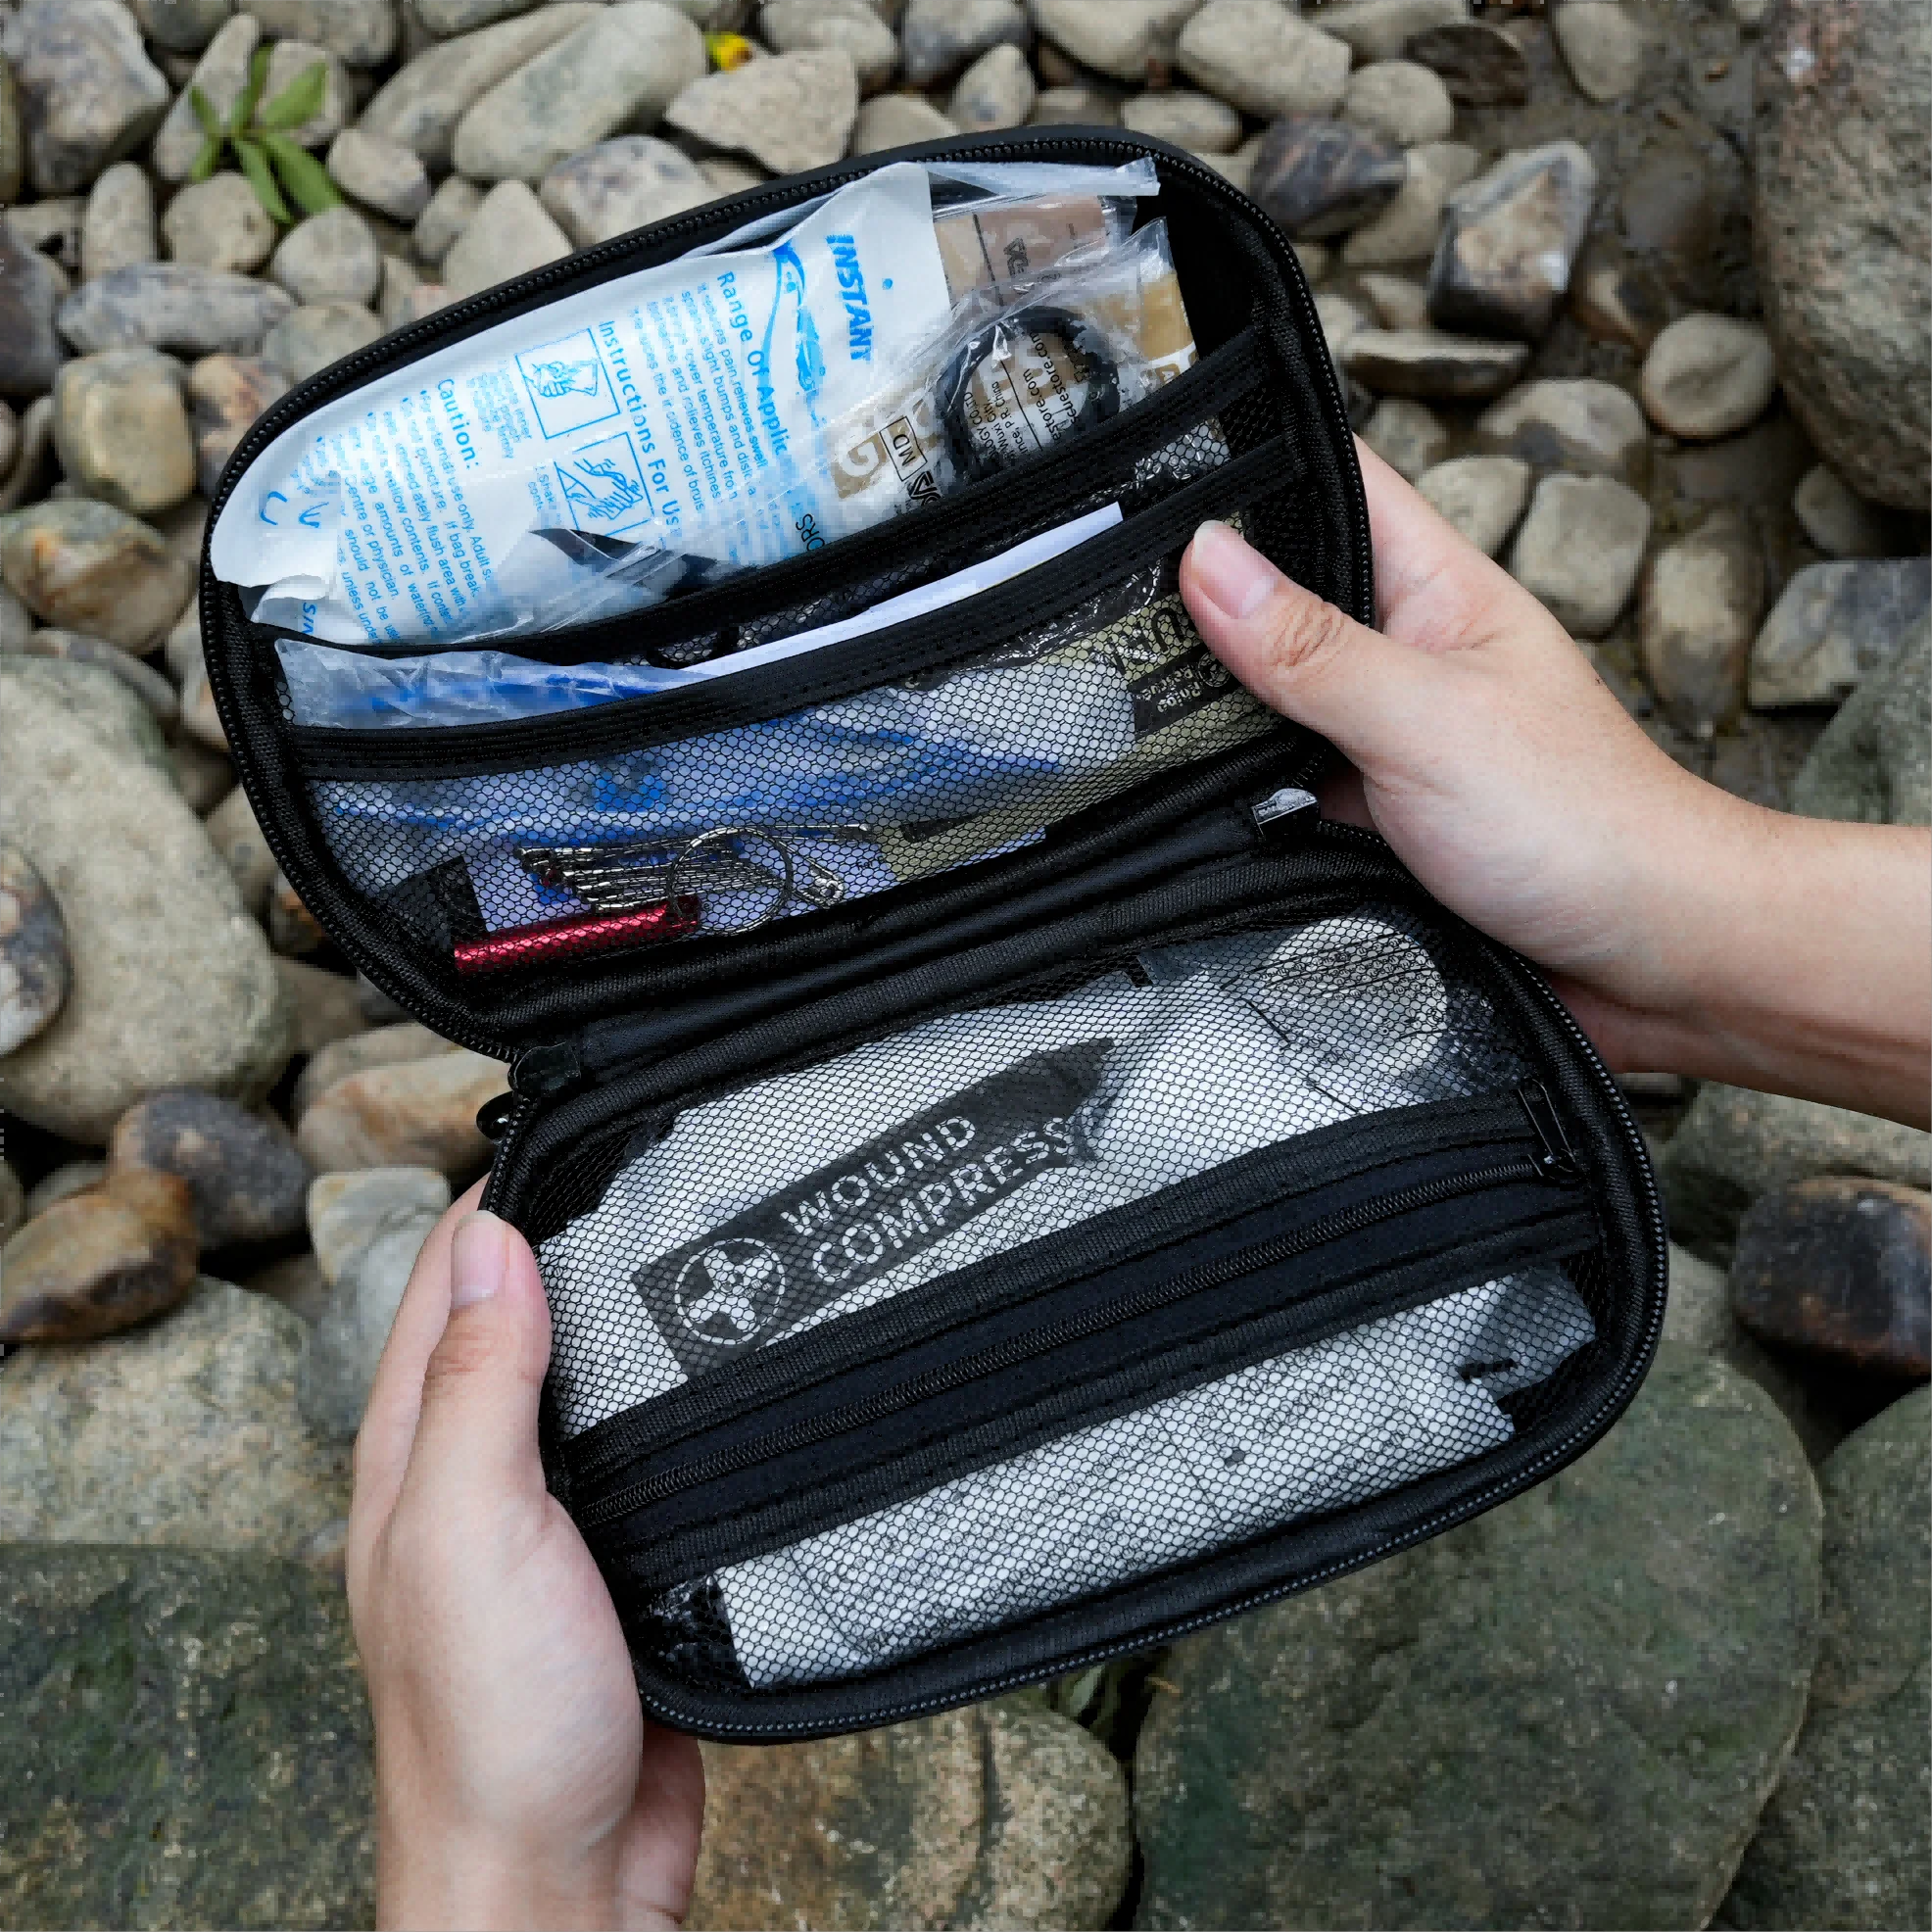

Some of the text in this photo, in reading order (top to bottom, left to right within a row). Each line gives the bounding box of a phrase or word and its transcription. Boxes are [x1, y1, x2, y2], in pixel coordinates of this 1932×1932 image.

[713, 270, 755, 345] Range
[824, 232, 876, 362] INSTANT
[597, 318, 660, 456] Instructions
[652, 371, 670, 396] the
[745, 348, 770, 379] Of
[987, 380, 1007, 408] China
[435, 376, 483, 470] Caution:
[670, 365, 690, 393] and
[680, 396, 707, 448] relieves
[697, 449, 725, 499] itchines
[693, 388, 732, 468] temperature
[709, 374, 738, 422] bumps
[726, 423, 746, 450] and
[749, 382, 795, 458] Applic
[990, 422, 1009, 451] Wuxi
[646, 458, 674, 496] For
[682, 462, 697, 478] of
[747, 434, 768, 469] swell
[891, 432, 916, 465] MD
[444, 520, 458, 531] If
[446, 475, 463, 503] use
[455, 502, 477, 534] only.
[468, 533, 491, 567] Adult
[658, 499, 685, 527] Us
[687, 478, 707, 511] bruis
[361, 522, 374, 538] or
[373, 500, 405, 558] amounts
[398, 561, 413, 578] of
[400, 514, 432, 575] contents.
[426, 579, 440, 591] If
[446, 531, 467, 559] bag
[340, 569, 363, 611] unless
[343, 526, 369, 573] should
[364, 579, 381, 602] not
[375, 605, 390, 621] be
[366, 538, 401, 603] physician.
[424, 524, 446, 556] flush
[437, 557, 456, 586] area
[449, 585, 467, 607] with
[459, 558, 482, 597] break
[780, 1112, 980, 1237] WOUND
[807, 1116, 1076, 1285] COMPRESS
